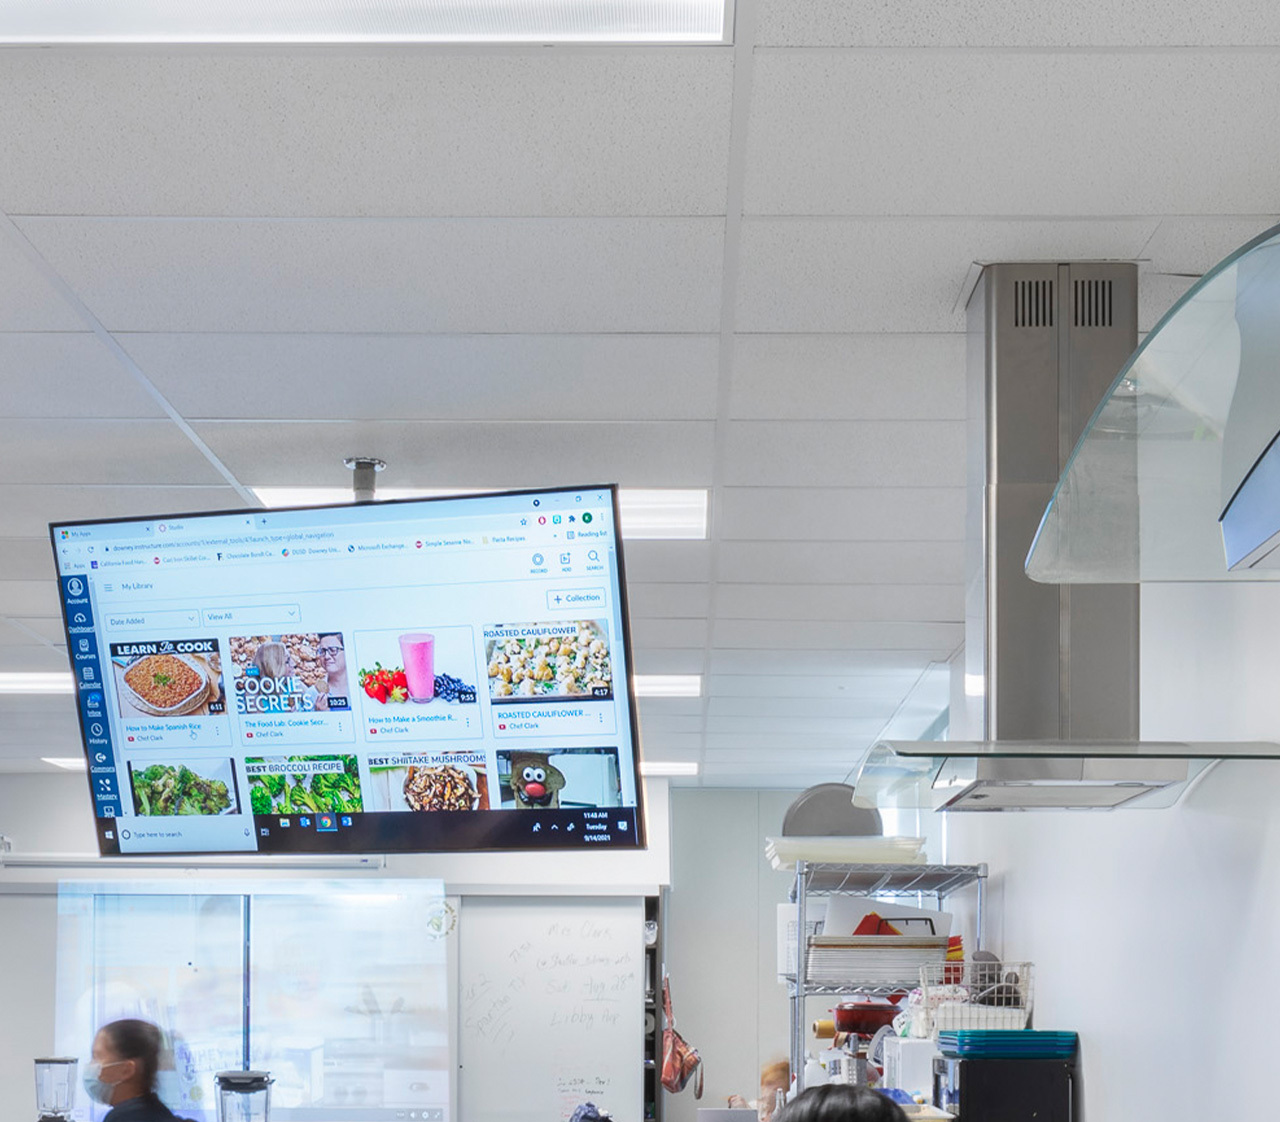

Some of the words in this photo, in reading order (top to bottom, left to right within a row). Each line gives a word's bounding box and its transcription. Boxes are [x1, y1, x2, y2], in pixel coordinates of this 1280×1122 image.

[122, 583, 131, 591] My
[566, 594, 600, 603] Collection
[224, 612, 232, 620] All
[483, 628, 519, 638] ROASTED
[521, 626, 577, 636] CAULIFLOWER
[117, 644, 157, 655] LEARN
[177, 641, 213, 653] COOK
[234, 676, 303, 695] COOKIE
[593, 688, 608, 696] 4:17
[460, 693, 475, 701] 9:55
[236, 693, 314, 713] SECRETS
[329, 698, 346, 706] 10:25
[210, 703, 223, 711] 6:11
[498, 711, 530, 719] ROASTED
[532, 709, 583, 718] CAULIFLOWER
[165, 723, 187, 732] Spanish
[189, 722, 201, 730] Rice
[257, 720, 273, 728] Food
[288, 719, 309, 727] Cookie
[391, 756, 429, 765] SHIITAKE
[245, 765, 267, 773] BEST
[268, 763, 311, 772] BROCCOLI
[312, 762, 342, 771] RECIPE
[586, 823, 608, 831] Tuesday
[584, 834, 611, 842] 9/14/2021
